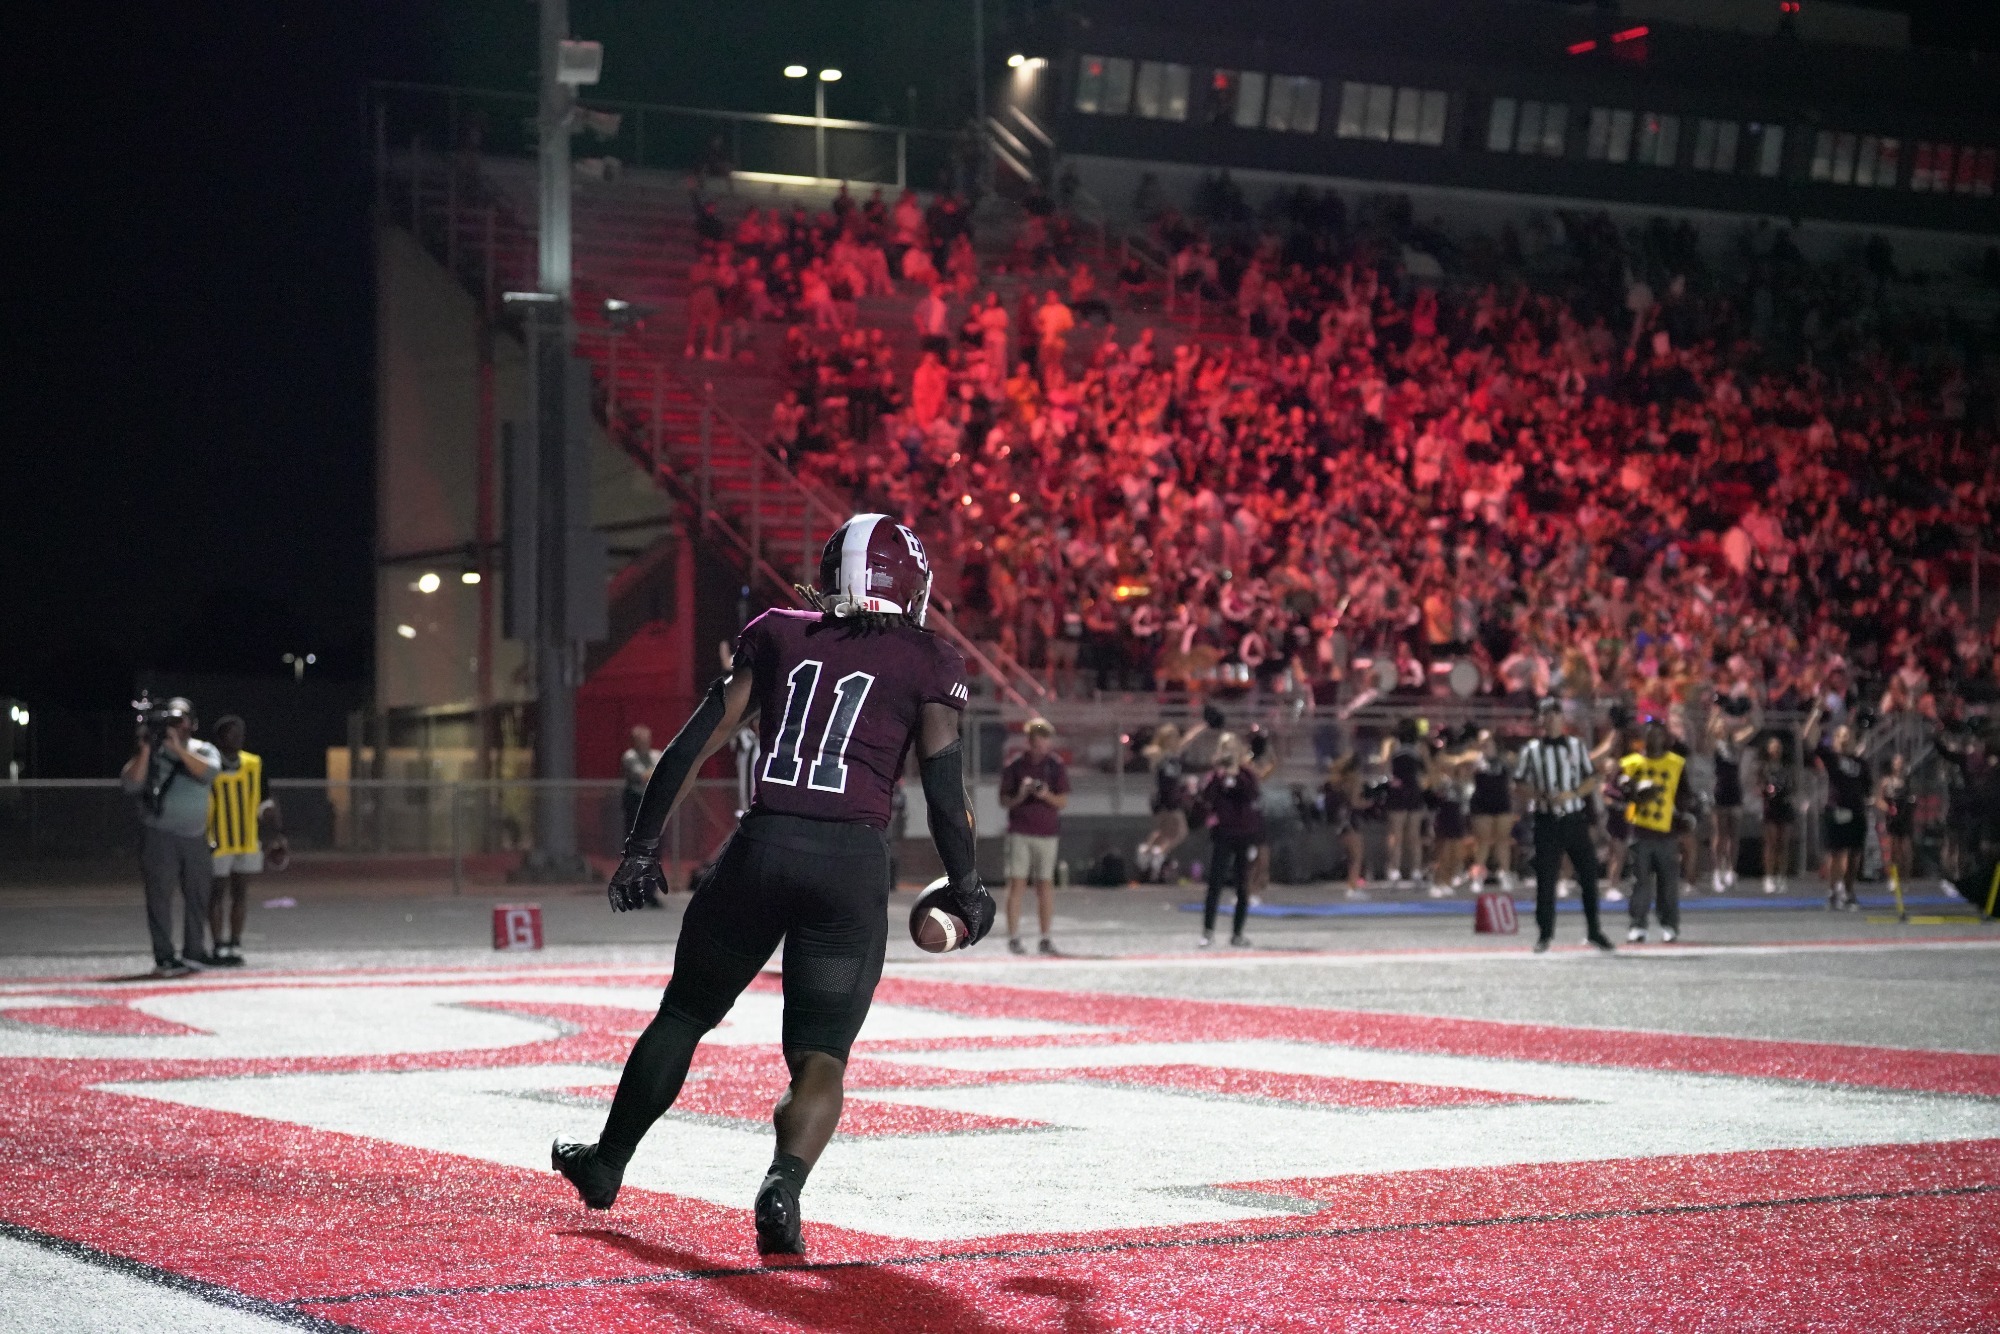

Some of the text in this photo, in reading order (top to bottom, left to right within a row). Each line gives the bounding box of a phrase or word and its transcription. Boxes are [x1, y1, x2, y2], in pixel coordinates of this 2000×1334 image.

[762, 659, 876, 794] 11
[505, 909, 536, 952] G
[1485, 896, 1516, 934] 10
